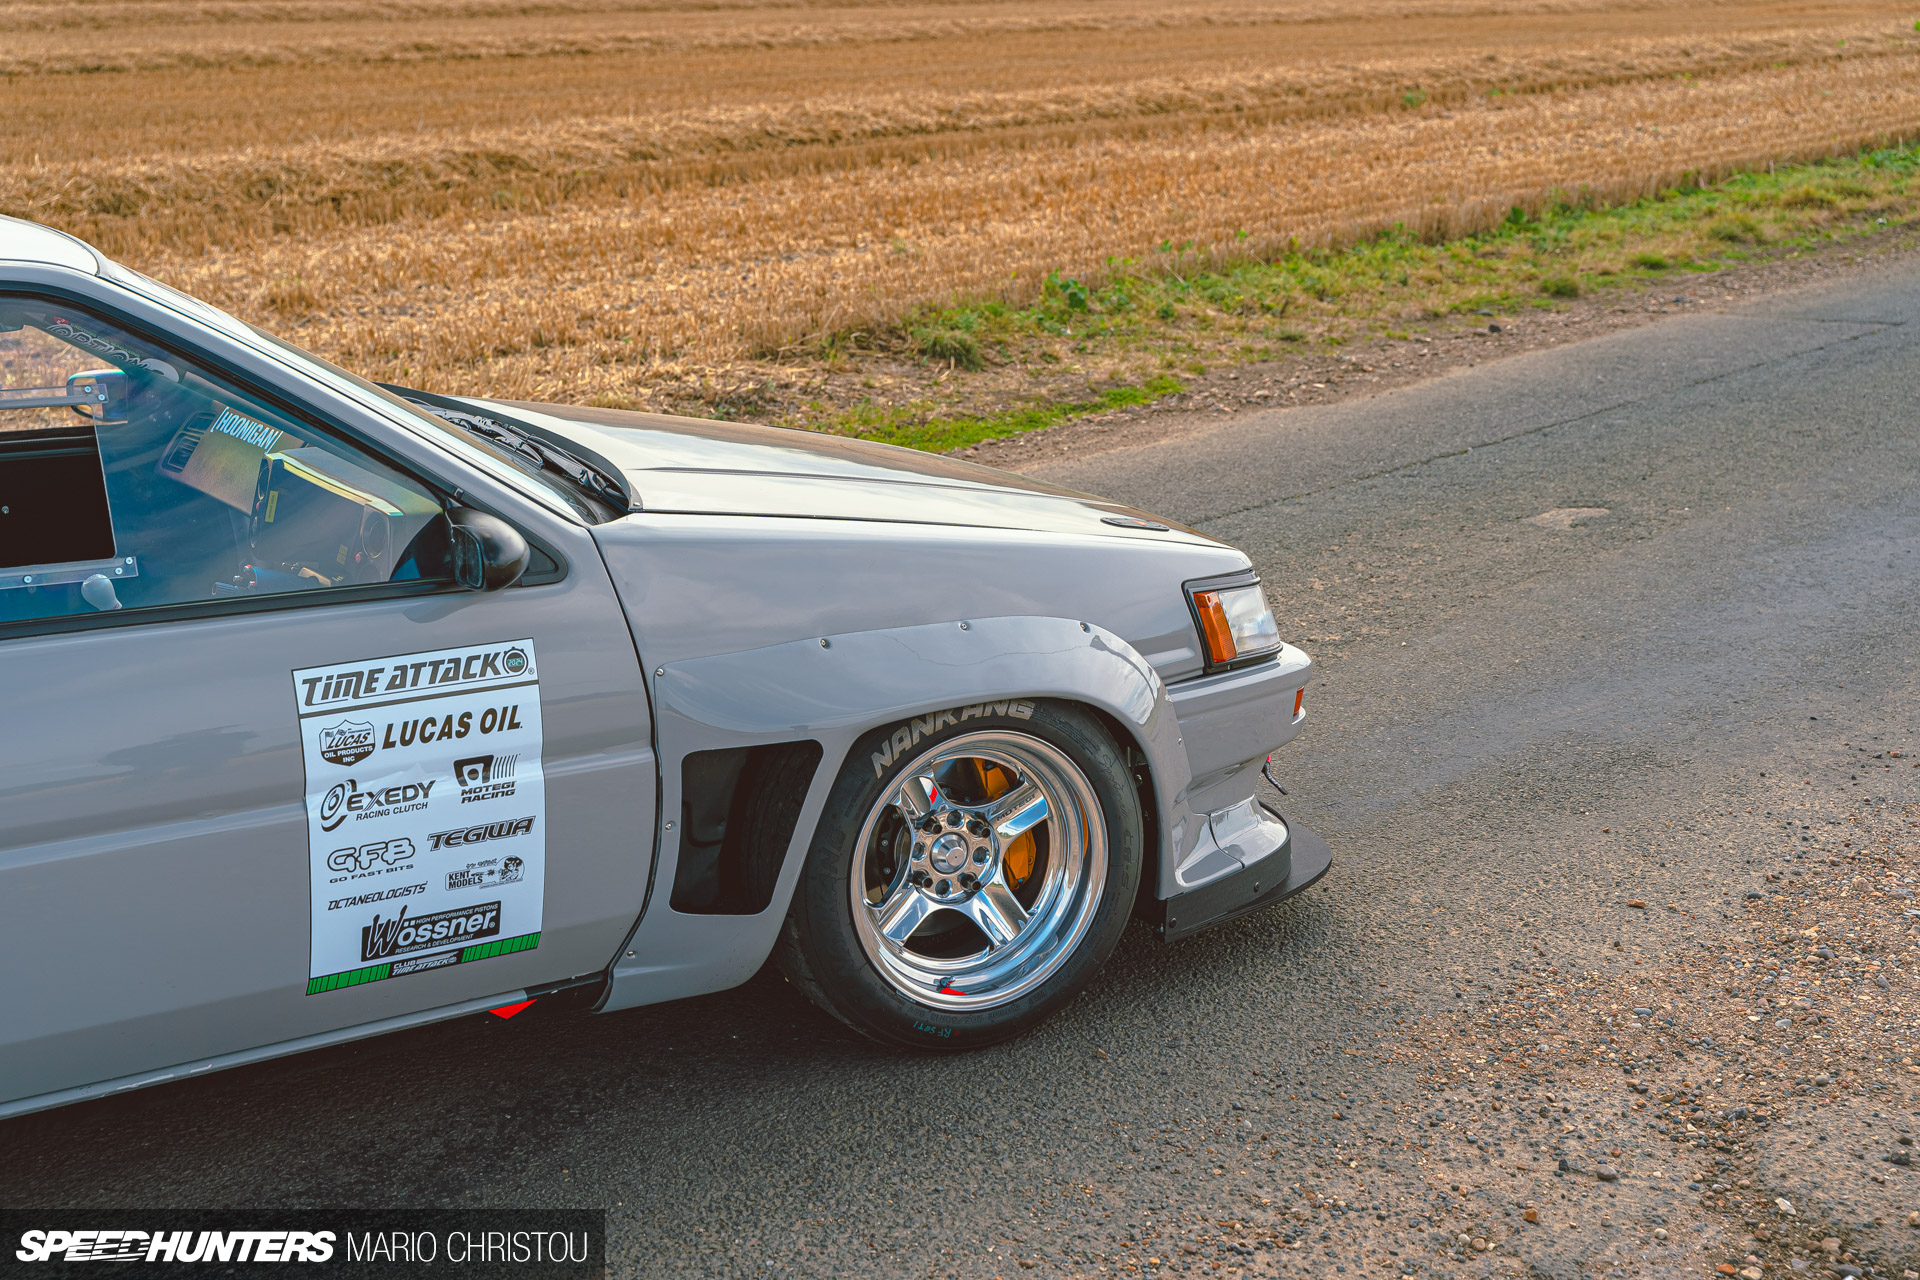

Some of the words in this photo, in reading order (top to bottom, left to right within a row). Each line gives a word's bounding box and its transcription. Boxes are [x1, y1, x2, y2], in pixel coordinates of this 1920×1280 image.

[384, 651, 502, 691] ATTACK
[382, 711, 473, 750] LUCAS
[479, 704, 521, 735] OIL
[326, 731, 371, 750] LUCAS
[870, 699, 1036, 779] NANKANG
[324, 751, 337, 759] OIL
[337, 745, 374, 757] PRODUCTS
[342, 755, 356, 763] INC
[346, 780, 436, 812] EXEDY
[460, 781, 517, 796] MOTEGI
[460, 789, 516, 804] RACING
[355, 808, 391, 821] RACING
[392, 802, 429, 815] CLUTCH
[996, 793, 1036, 822] MOTEGI
[427, 815, 536, 851] TEGIWA
[327, 837, 416, 873] GFB
[329, 876, 349, 884] GO
[351, 870, 382, 880] FAST
[385, 863, 414, 875] BITS
[448, 870, 471, 882] KENT
[448, 875, 483, 890] MODELS
[327, 884, 427, 911] OCTANEOLOGISTS
[416, 916, 430, 925] HIGH
[430, 908, 474, 921] PERFORMANCE
[473, 903, 499, 914] PISTONS
[366, 904, 497, 959] Wössner
[394, 944, 427, 954] RESEARCH
[431, 933, 475, 946] DEVELOPMENT
[393, 960, 416, 970] CLUB
